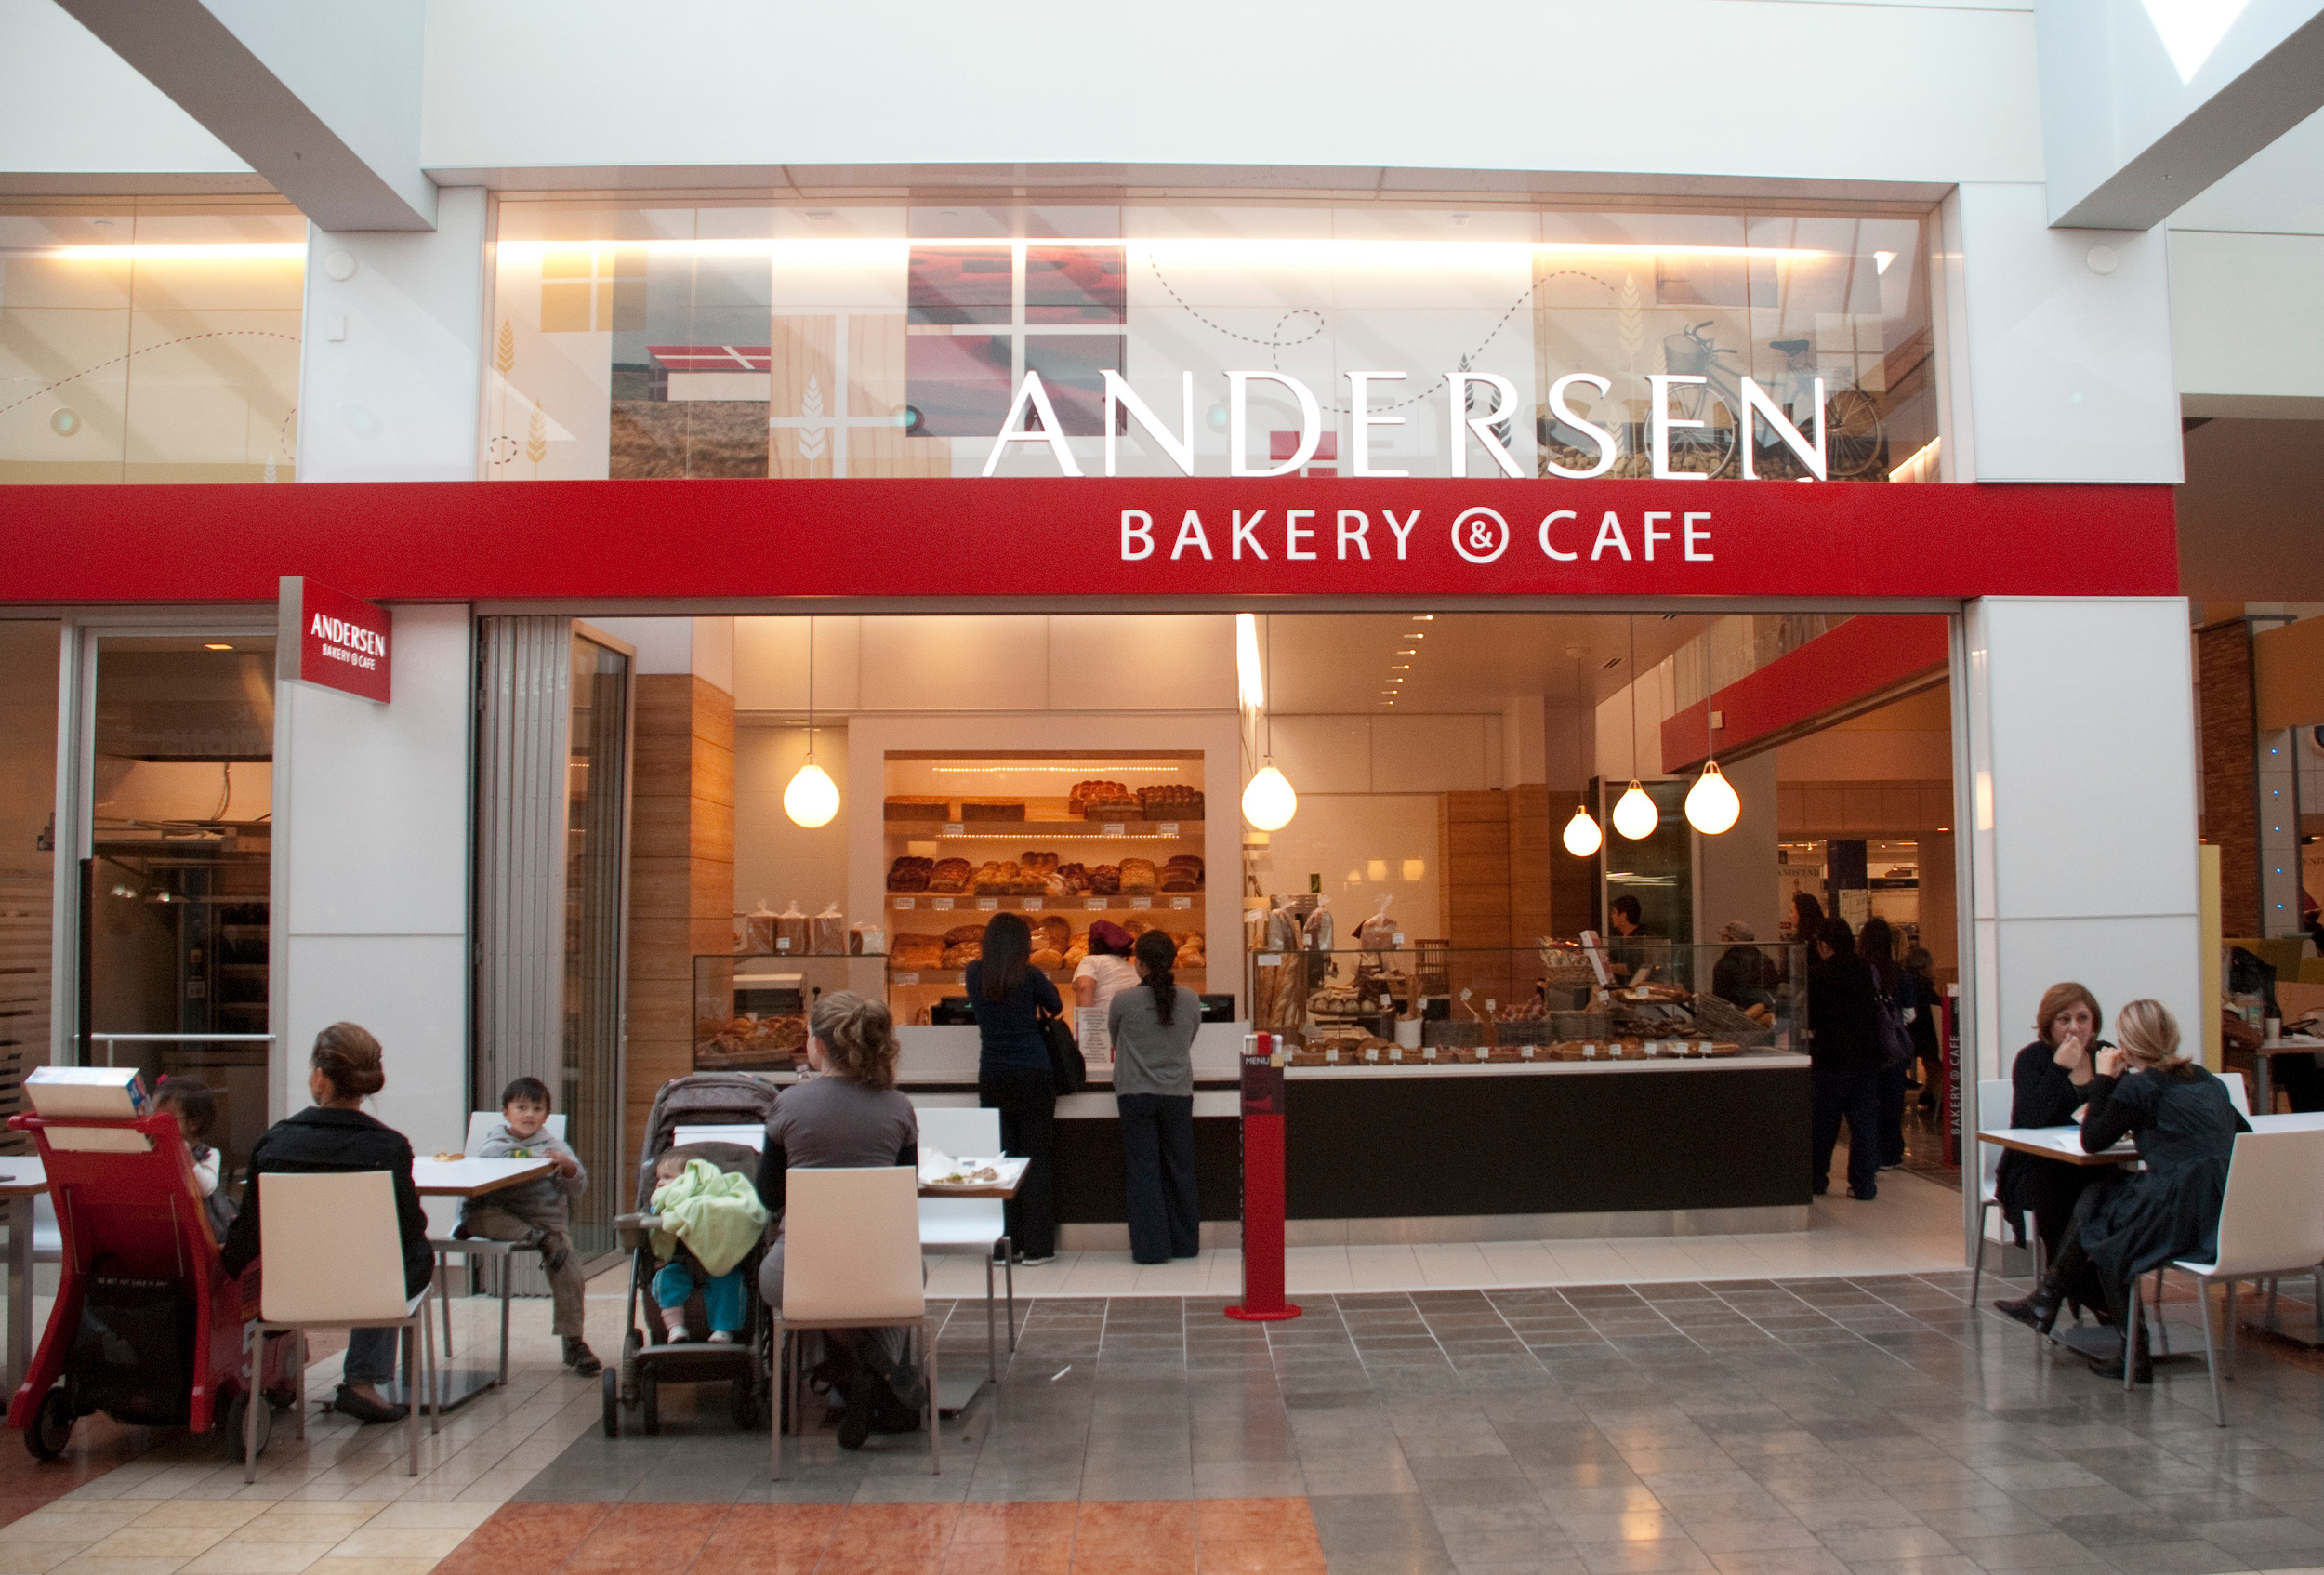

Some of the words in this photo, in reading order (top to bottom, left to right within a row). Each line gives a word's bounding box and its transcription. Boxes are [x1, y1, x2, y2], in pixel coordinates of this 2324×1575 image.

[981, 369, 1829, 481] ANDERSEN
[1120, 509, 1421, 561] BAKERY
[1450, 506, 1510, 564] &
[1538, 509, 1715, 562] CAFE
[310, 613, 385, 657] ANDERSEN
[322, 643, 350, 662] BAKERY
[358, 655, 376, 670] CAFE
[1245, 1056, 1270, 1065] MENU
[1950, 1084, 1961, 1135] BAKERY
